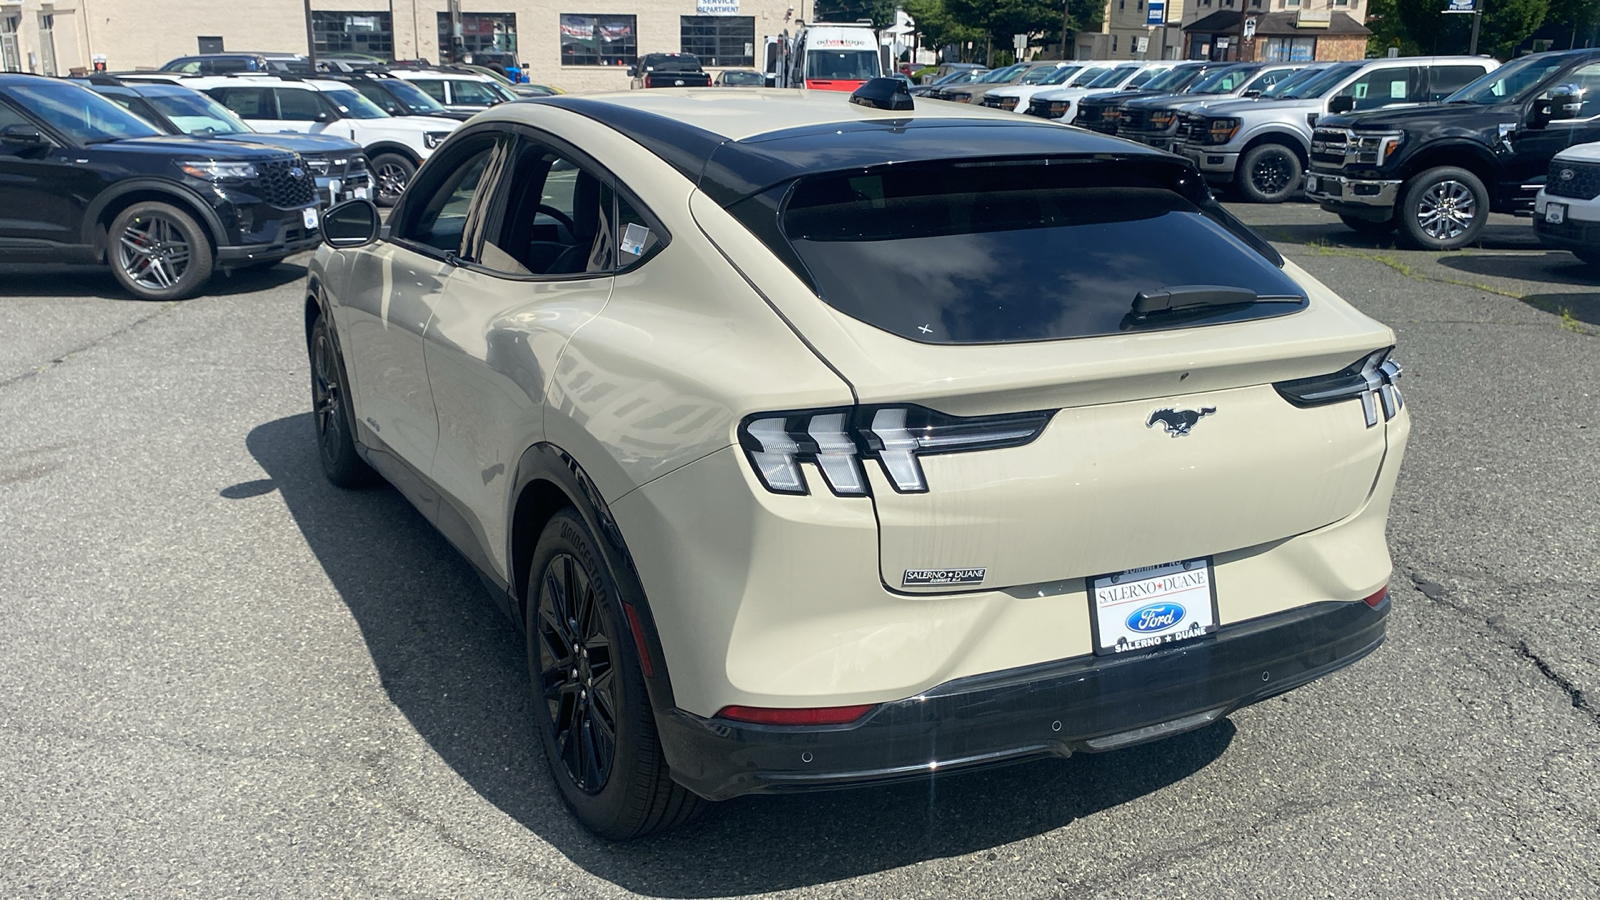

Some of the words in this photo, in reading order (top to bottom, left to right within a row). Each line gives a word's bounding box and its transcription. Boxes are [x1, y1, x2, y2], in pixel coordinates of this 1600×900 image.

[560, 521, 611, 615] BRIDGESTONE
[907, 571, 947, 580] SALERNO
[954, 569, 984, 578] DUANE
[1098, 581, 1157, 605] SALERNO
[1163, 571, 1206, 592] DUANE
[1138, 606, 1175, 630] Ford
[1114, 637, 1162, 653] SALERNO
[1175, 626, 1207, 641] DUANE
